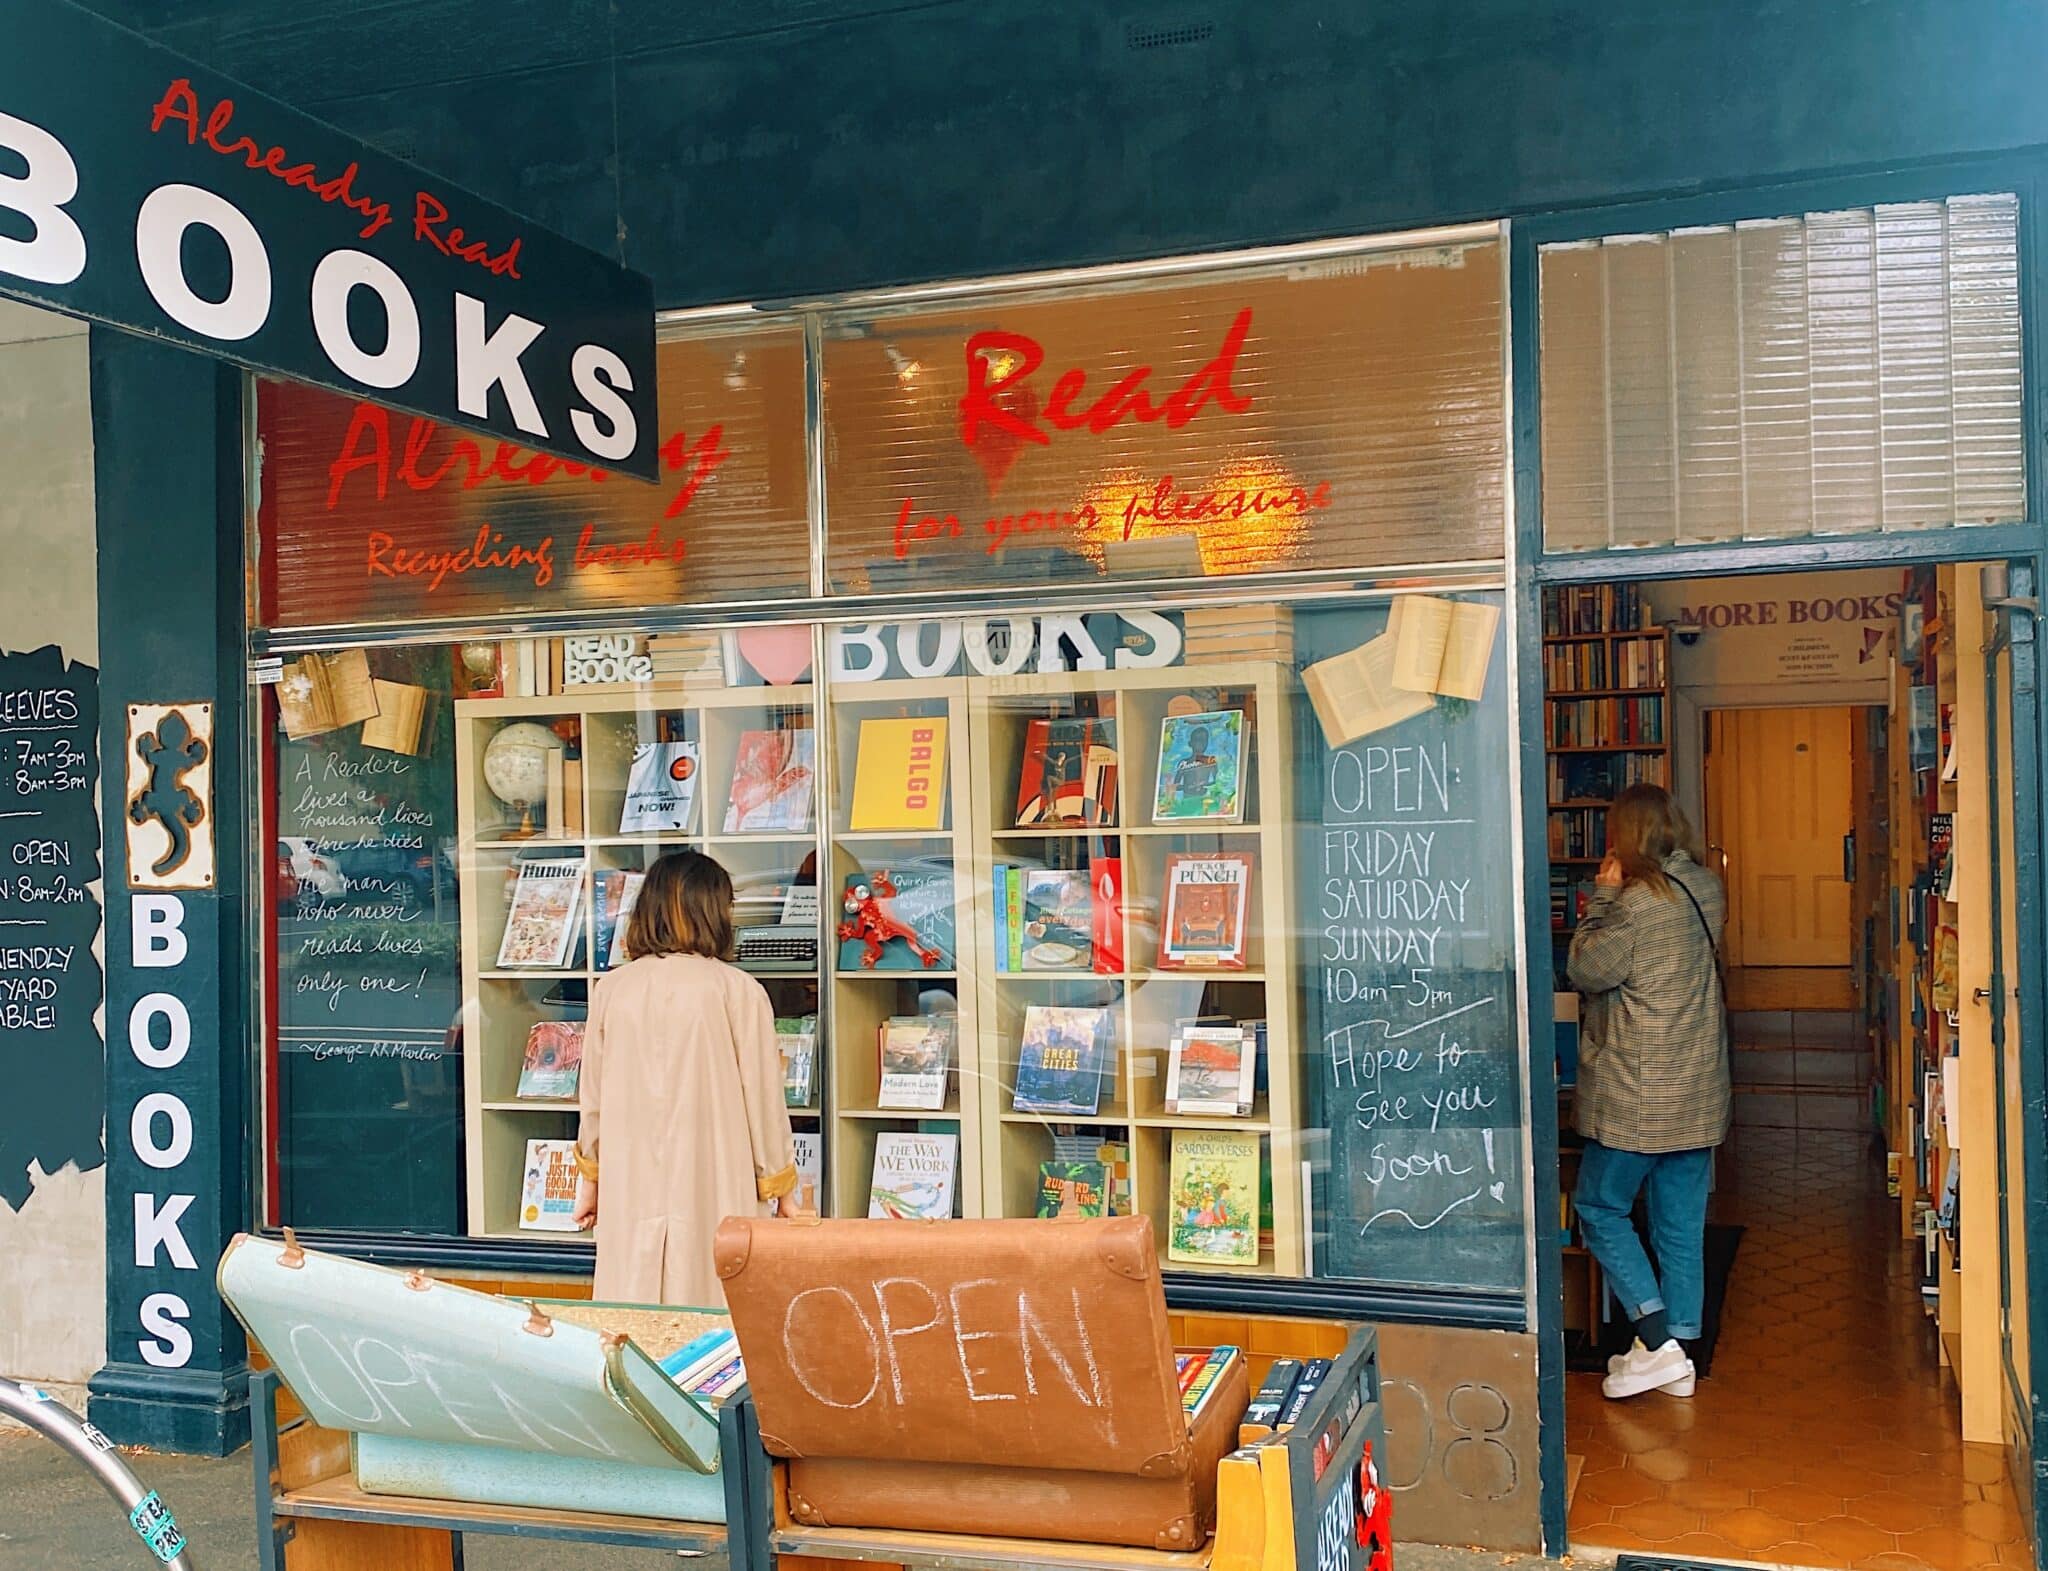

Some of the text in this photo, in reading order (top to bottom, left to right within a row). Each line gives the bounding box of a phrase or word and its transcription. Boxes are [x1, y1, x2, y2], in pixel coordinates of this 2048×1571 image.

[151, 79, 521, 279] Already Read
[0, 112, 638, 460] BOOKS
[958, 307, 1252, 446] Read
[894, 475, 1333, 560] for your pleasure
[368, 523, 686, 592] Recycling books
[1680, 593, 1902, 628] MORE BOOKS
[565, 635, 634, 659] READ
[830, 611, 1182, 682] BOOKS
[565, 656, 653, 683] BOOKS
[0, 690, 78, 722] EEVES
[296, 752, 411, 783] A Reader
[906, 728, 934, 811] BALGO
[293, 785, 377, 812] lives a
[638, 803, 676, 813] NOW!
[389, 800, 433, 827] lives
[13, 840, 71, 865] OPEN
[352, 833, 379, 849] he
[383, 834, 423, 849] dies
[1325, 830, 1434, 876] FRIDAY
[522, 863, 577, 878] Humor
[1180, 870, 1239, 882] PUNCH
[343, 877, 397, 893] man
[296, 901, 423, 921] who never
[1322, 878, 1471, 922] SATURDAY
[300, 930, 424, 956] reads lives
[1323, 925, 1442, 966] SUNDAY
[0, 946, 74, 972] IENDLY
[297, 971, 349, 1011] only
[1042, 1058, 1079, 1070] CITIES
[1043, 1047, 1080, 1058] GREAT
[1324, 1025, 1470, 1093] Hope to
[1422, 1086, 1496, 1133] you
[129, 894, 198, 1367] BOOKS
[889, 1144, 943, 1157] THE WAY
[1175, 1143, 1215, 1155] GARDEN
[1220, 1144, 1254, 1157] VERSES
[547, 1165, 568, 1176] JUST
[880, 1156, 950, 1172] WE WORK
[546, 1176, 567, 1188] GOOD
[1044, 1177, 1090, 1193] RUDRD
[783, 1277, 1107, 1408] OPEN
[290, 1324, 620, 1457] OPEN
